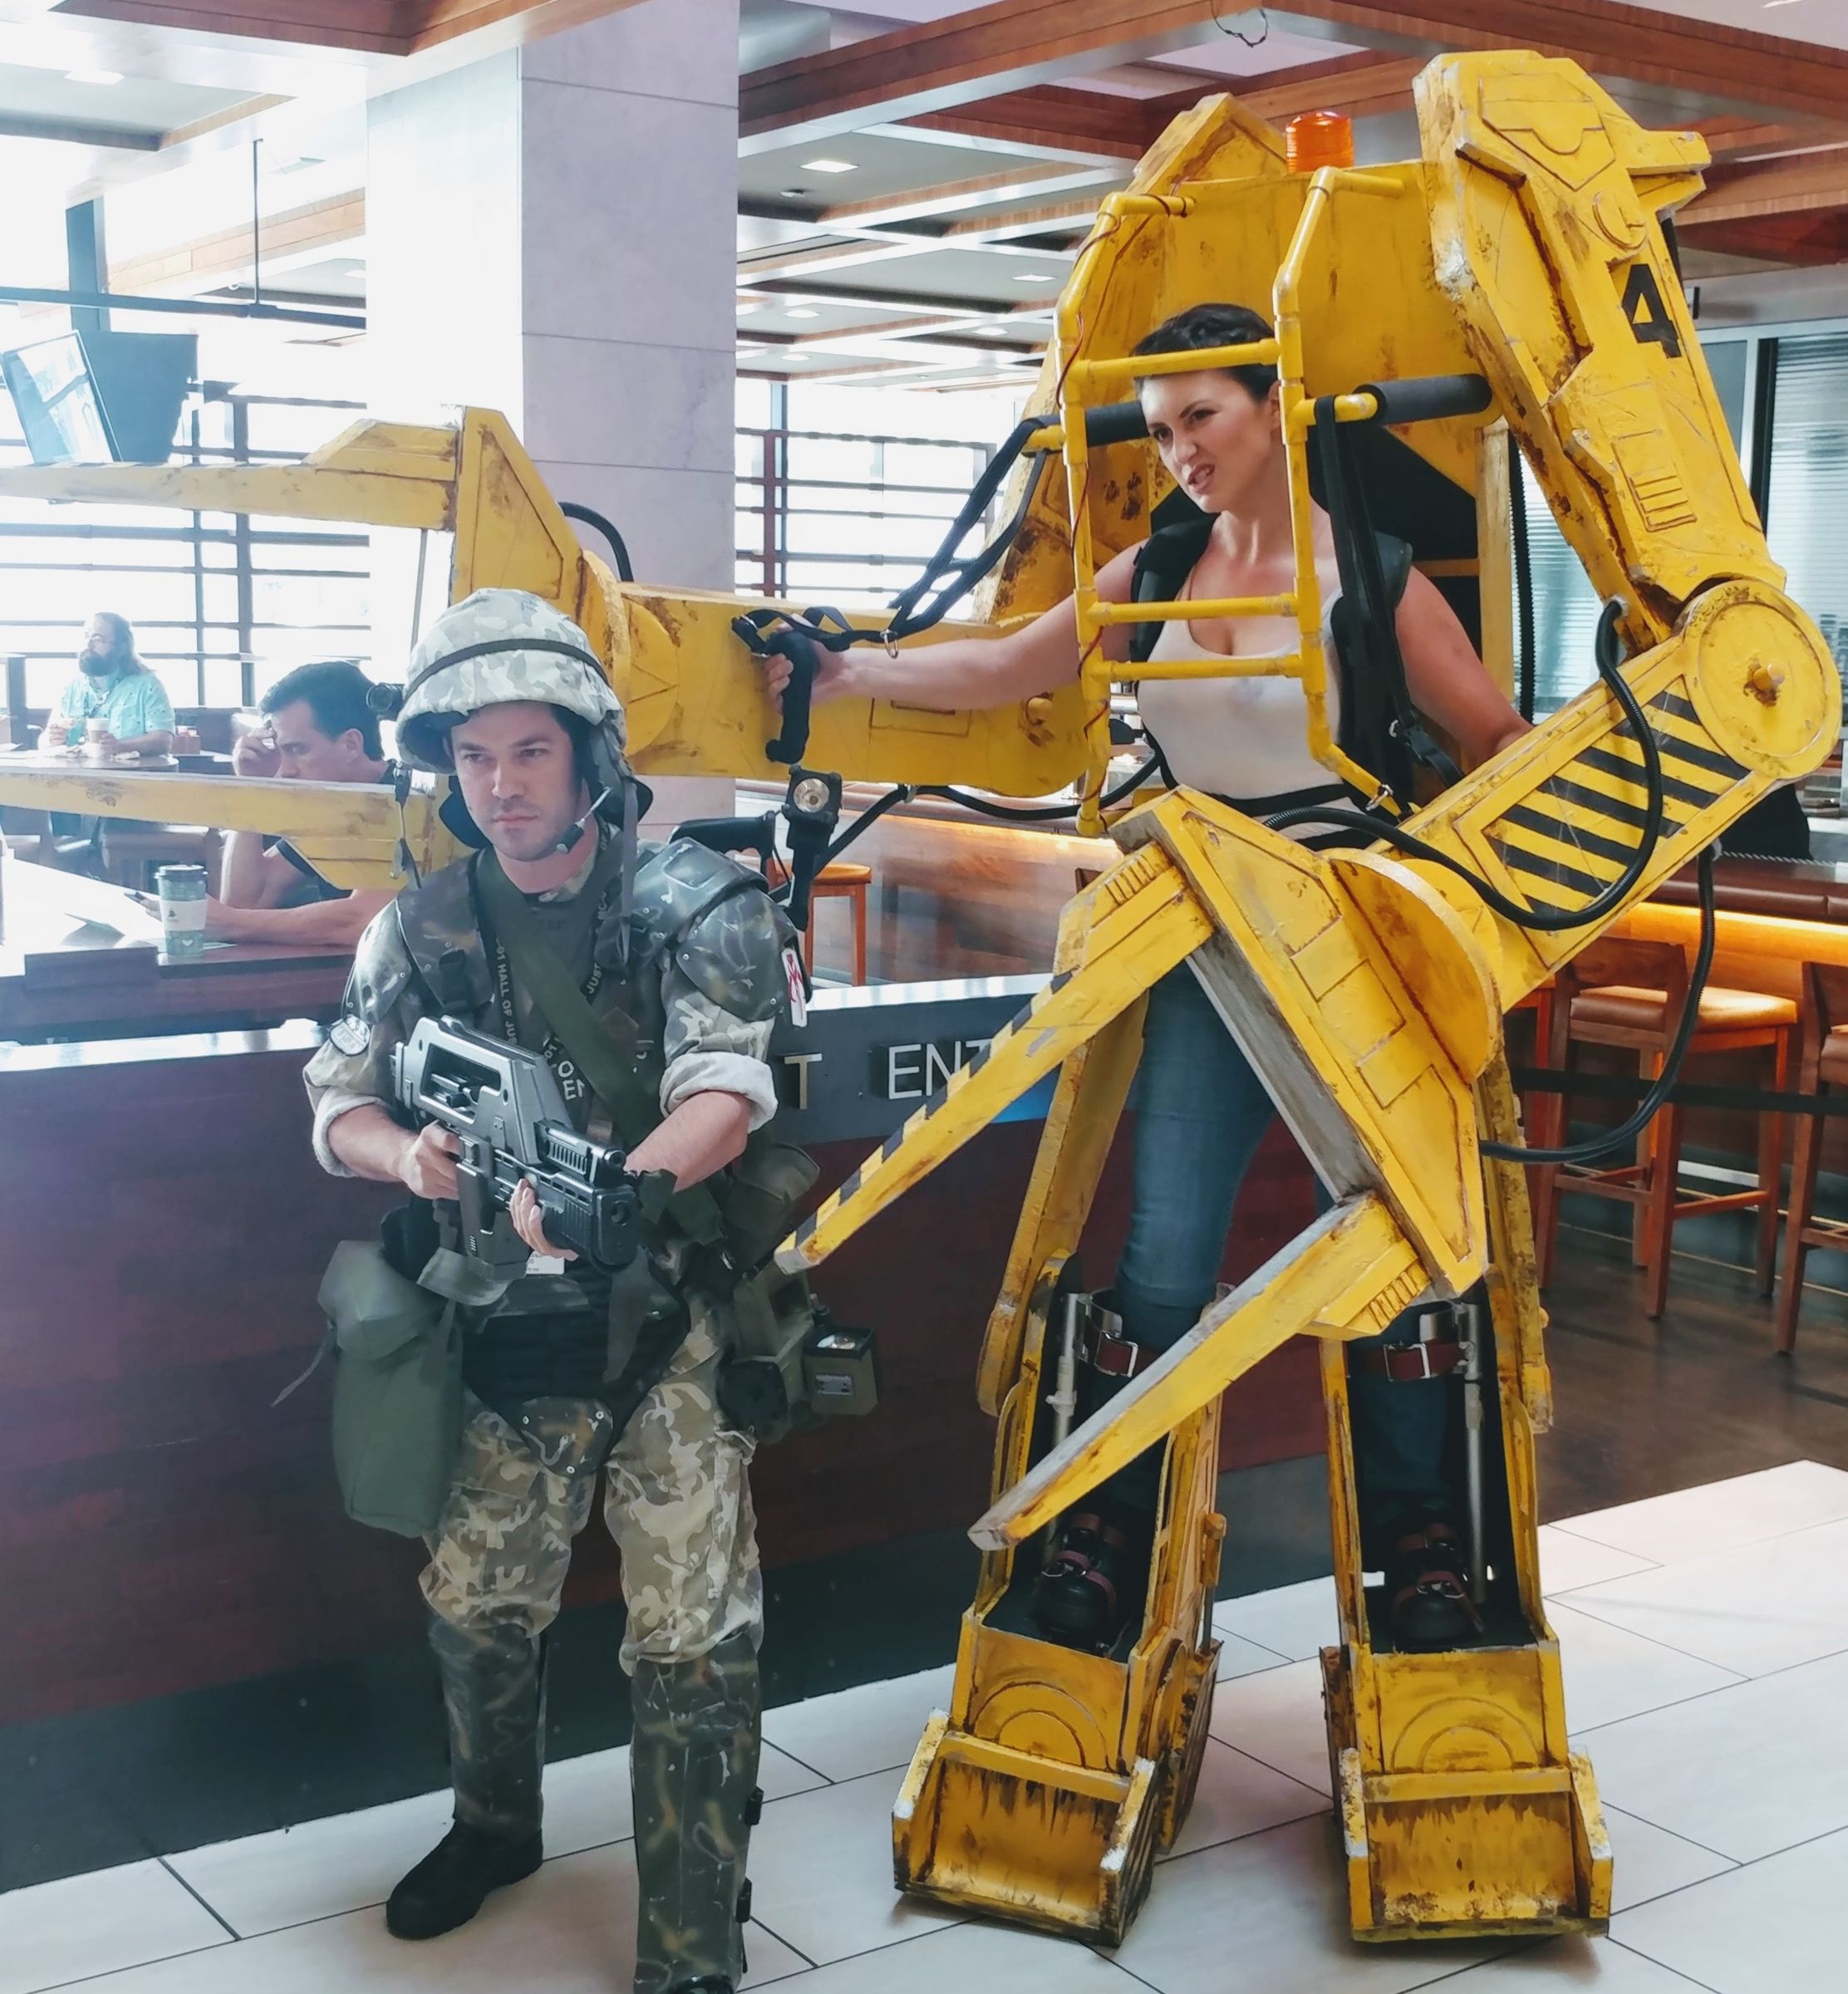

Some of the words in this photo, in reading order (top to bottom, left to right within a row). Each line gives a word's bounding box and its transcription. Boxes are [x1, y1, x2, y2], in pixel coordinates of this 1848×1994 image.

[1621, 263, 1683, 358] 4
[498, 964, 509, 997] HALL
[502, 999, 513, 1016] OF
